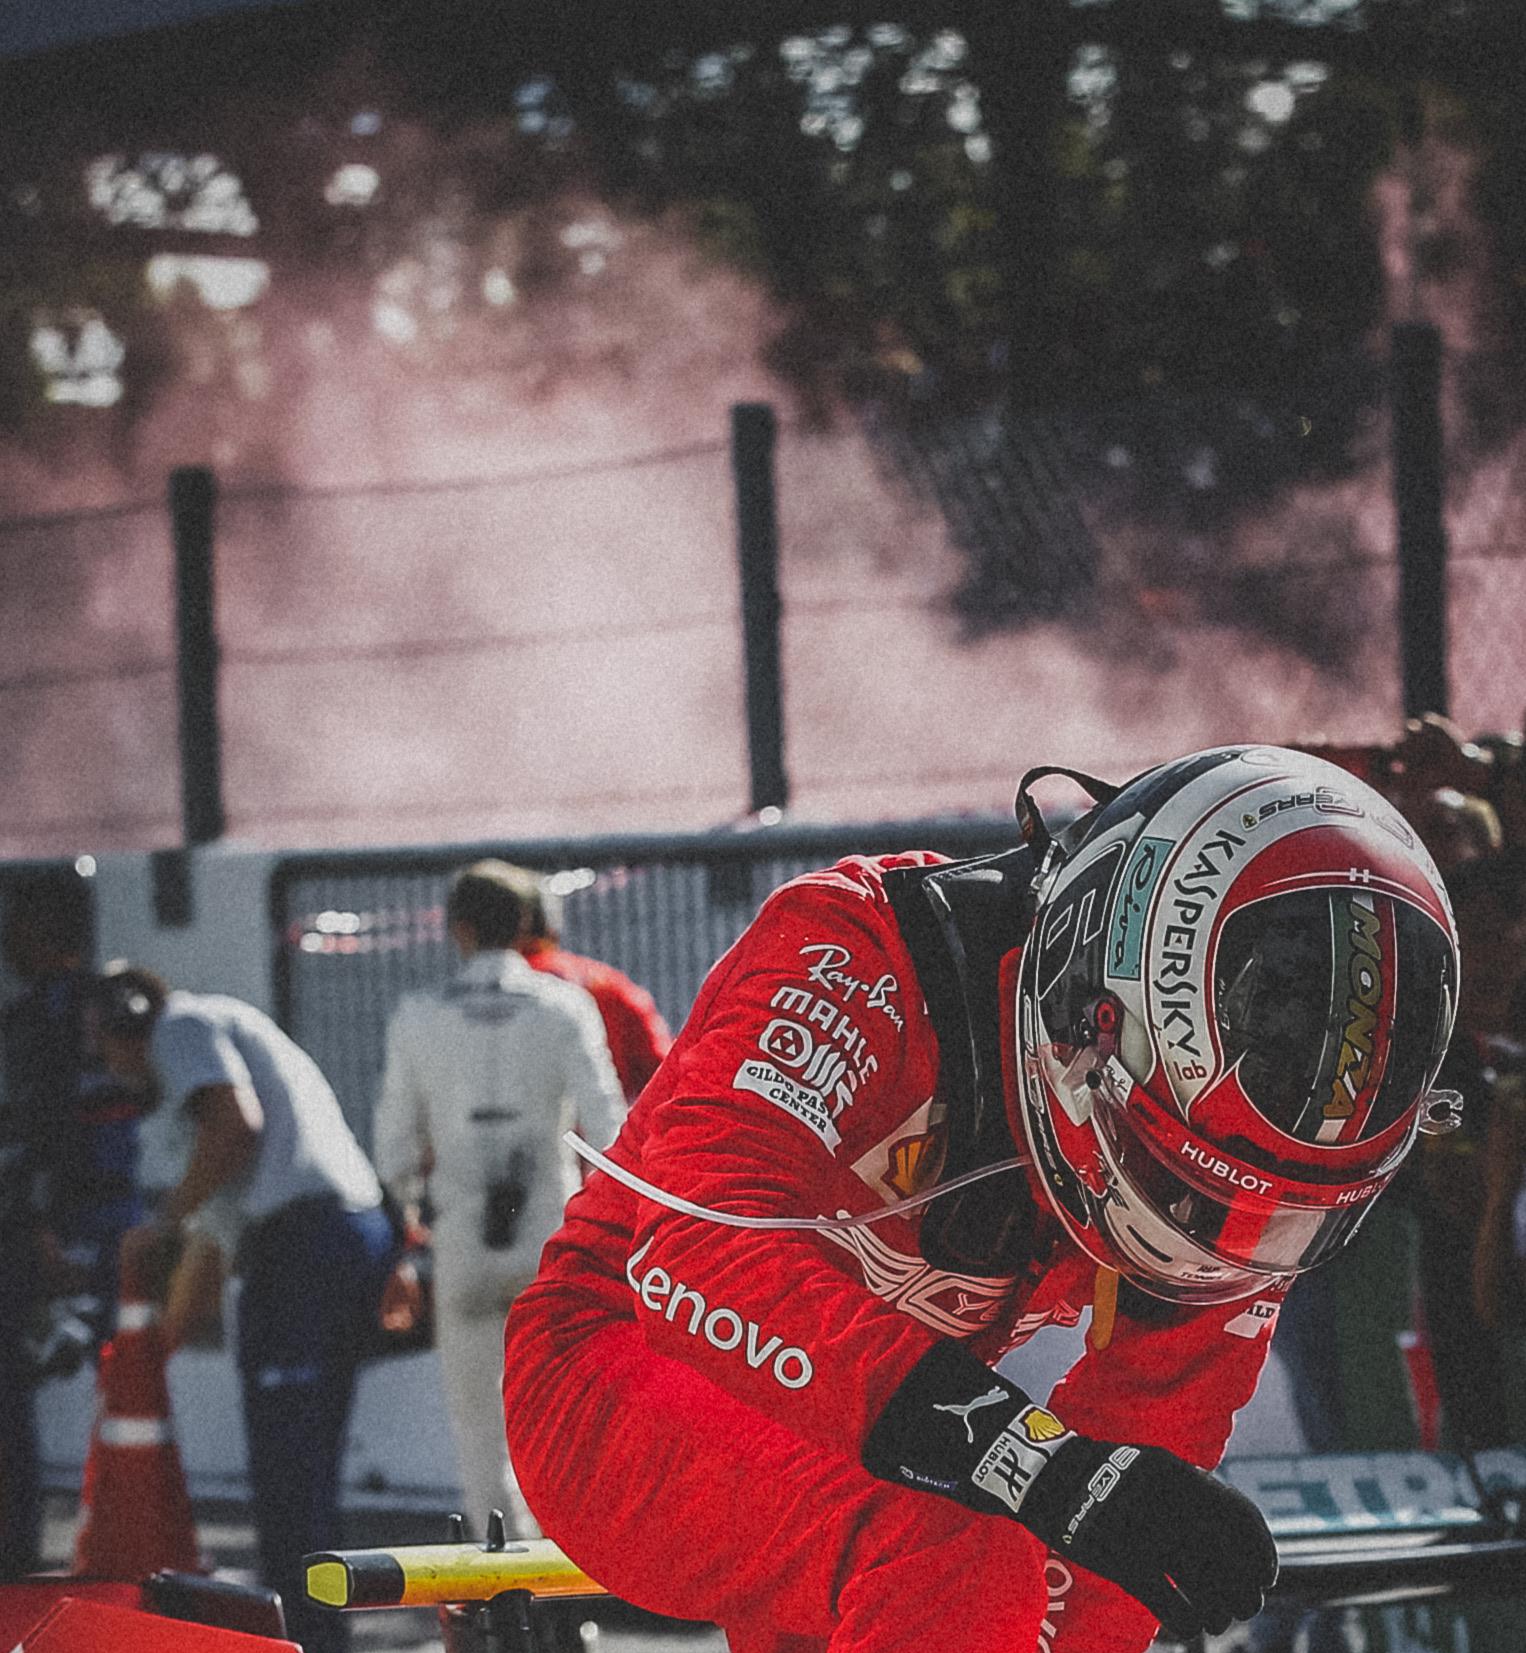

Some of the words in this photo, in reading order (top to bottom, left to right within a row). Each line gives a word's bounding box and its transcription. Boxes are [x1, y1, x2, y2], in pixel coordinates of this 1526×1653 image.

[1114, 844, 1156, 970] Riva
[1153, 829, 1246, 1057] KASPERSKY
[770, 986, 879, 1084] MAHLE
[1323, 903, 1381, 1118] MONZA
[746, 1066, 794, 1093] GILDO
[1173, 1059, 1207, 1081] lab
[769, 1088, 827, 1133] CENTER
[1181, 1141, 1273, 1195] HUBLOT
[1336, 1182, 1382, 1205] HUBL
[626, 1235, 814, 1389] Lenovo
[976, 1437, 1011, 1482] HUBLOT
